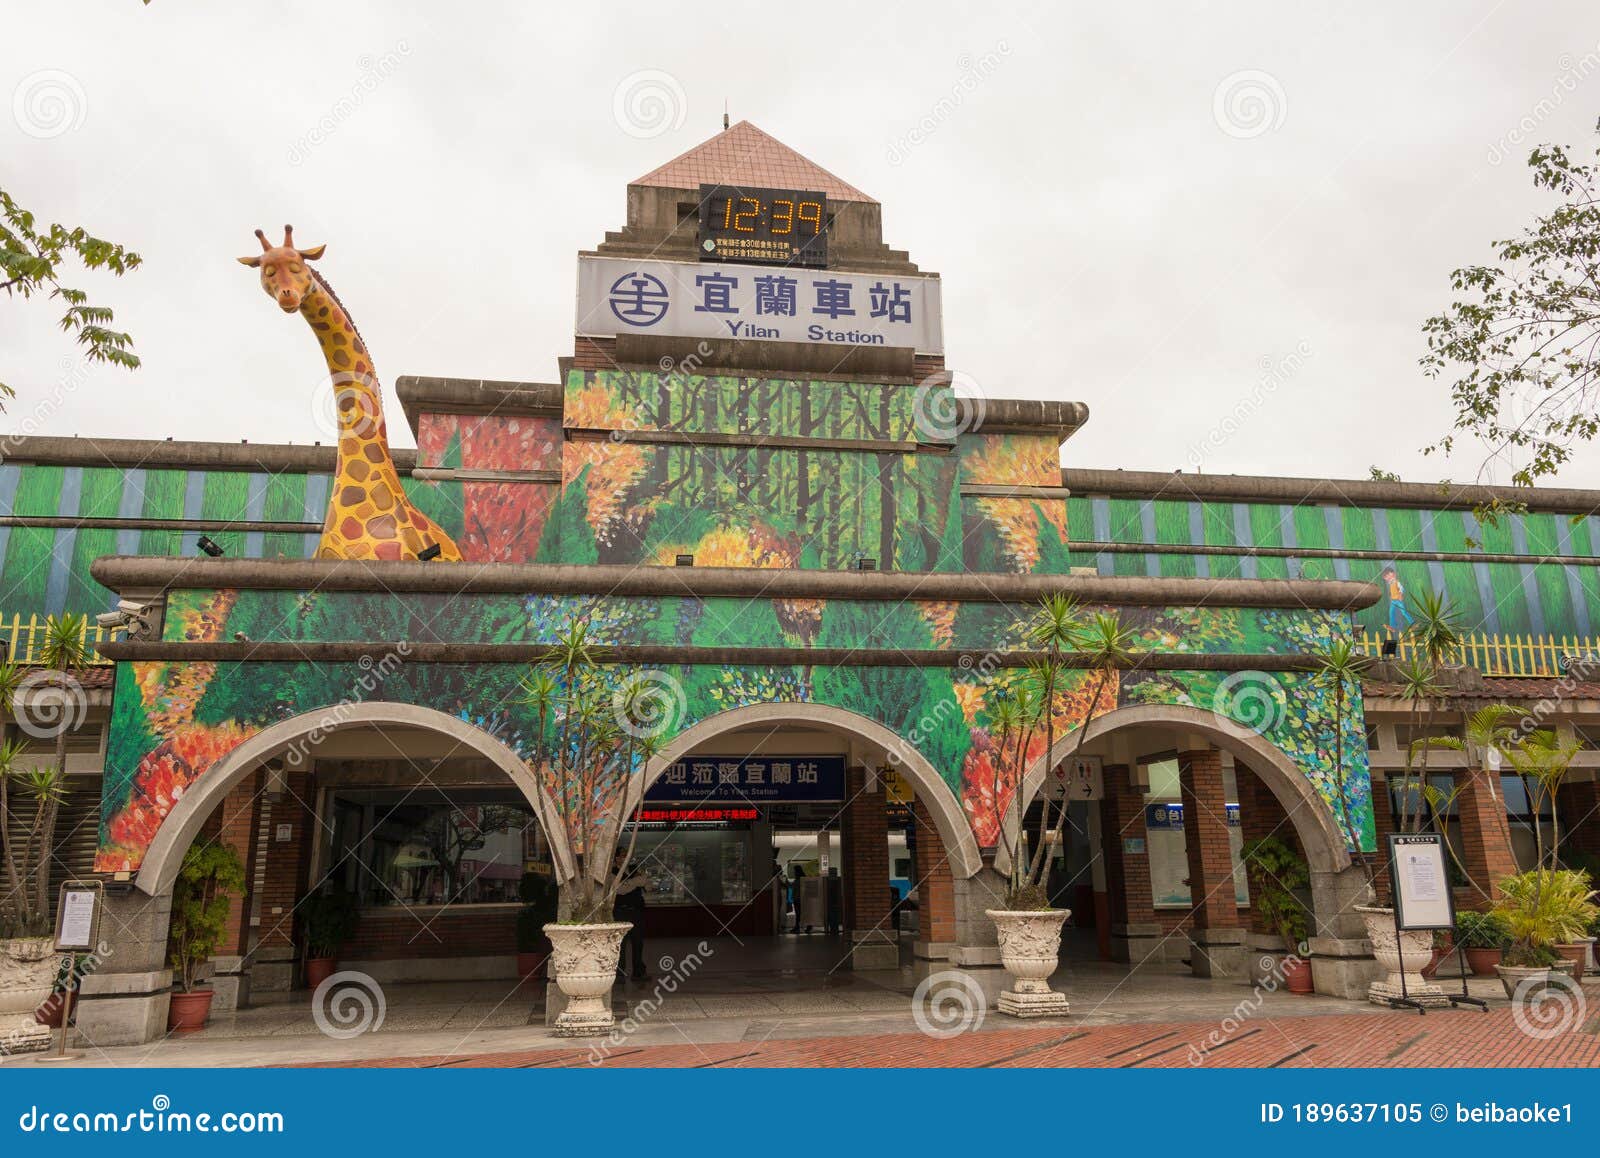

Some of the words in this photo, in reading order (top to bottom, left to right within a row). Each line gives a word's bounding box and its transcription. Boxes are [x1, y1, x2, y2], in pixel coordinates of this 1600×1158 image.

[725, 198, 821, 234] 12:39
[694, 271, 912, 324] 宜蘭車站
[725, 319, 780, 339] Yilan
[807, 325, 885, 345] Station
[655, 762, 819, 785] 迎蒞臨宜蘭站
[719, 788, 729, 796] To
[751, 788, 778, 796] Station
